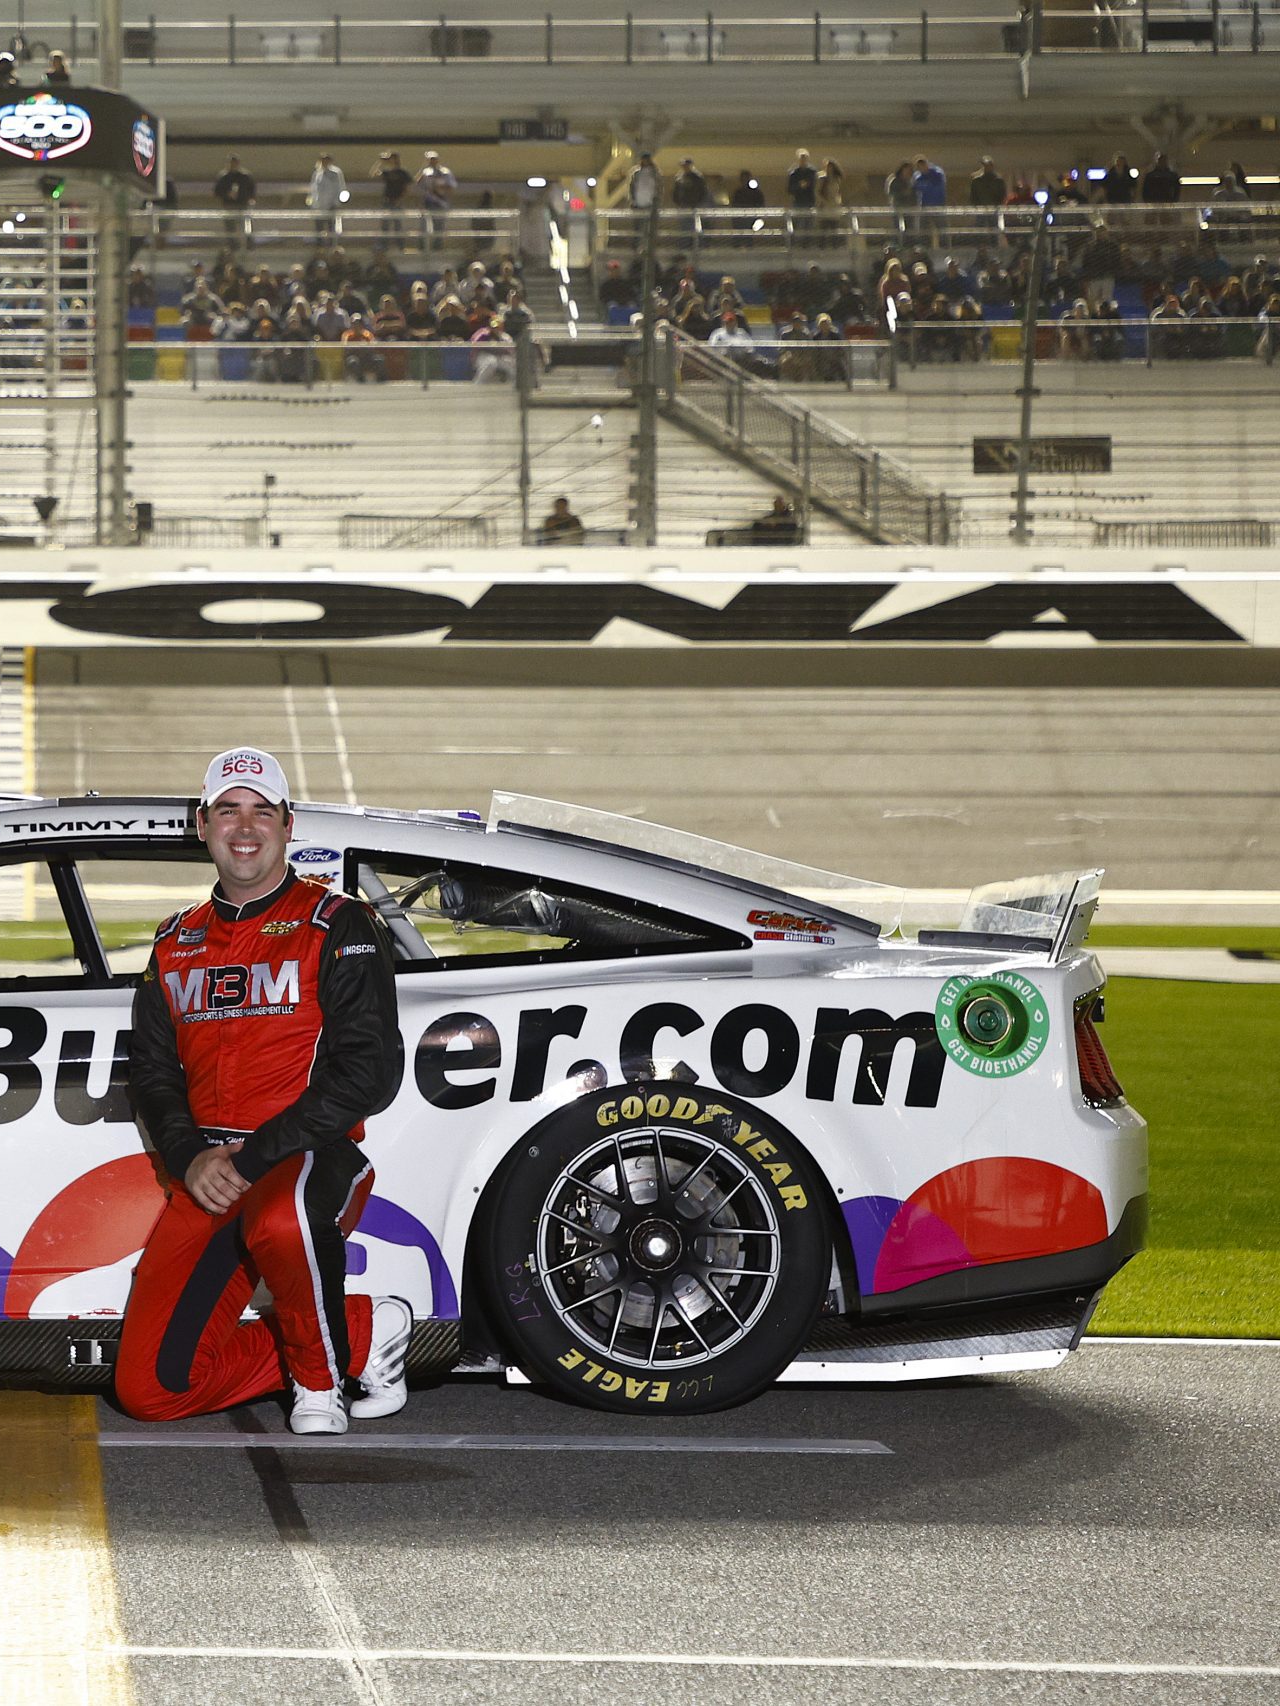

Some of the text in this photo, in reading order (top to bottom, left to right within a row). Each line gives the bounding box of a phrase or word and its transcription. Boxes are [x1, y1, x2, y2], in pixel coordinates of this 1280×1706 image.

[0, 115, 83, 138] 500
[224, 754, 262, 763] DAYTONA
[4, 819, 197, 833] TIMMY HIL
[298, 849, 332, 861] Ford
[346, 944, 376, 955] NASCAR
[164, 960, 300, 1014] MBM
[941, 983, 960, 1007] GET
[243, 1006, 281, 1016] MANAGEMENT
[281, 1005, 294, 1014] LLC
[947, 1036, 1043, 1075] GET BIOETHANOL
[557, 1347, 671, 1403] EAGLE
